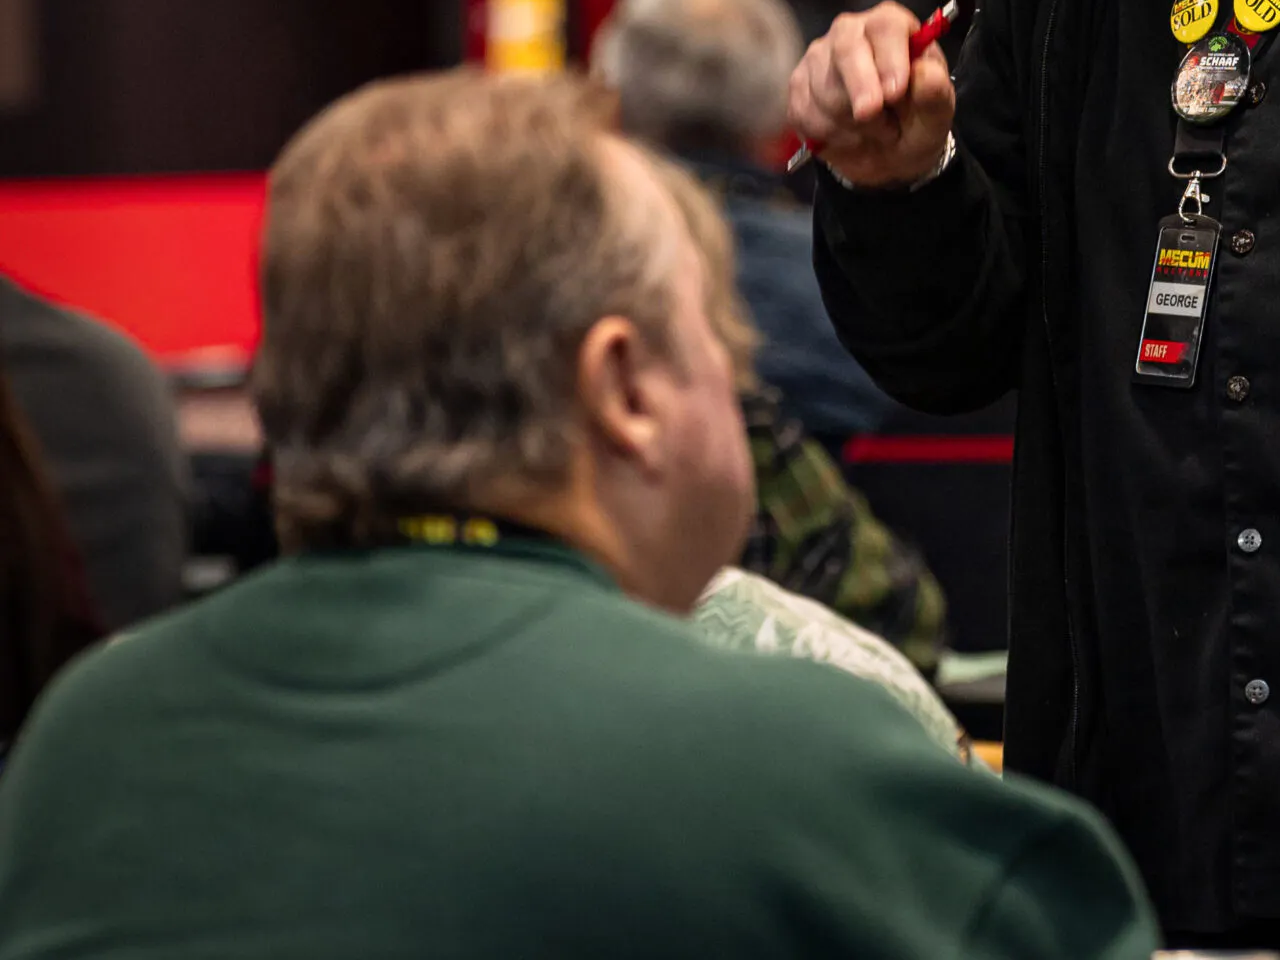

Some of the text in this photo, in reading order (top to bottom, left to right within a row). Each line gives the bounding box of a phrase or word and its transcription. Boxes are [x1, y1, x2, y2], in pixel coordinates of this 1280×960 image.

[1173, 1, 1212, 32] SOLD
[1200, 56, 1240, 67] SCHAAF
[1158, 248, 1211, 269] MECUM
[1156, 292, 1199, 309] GEORGE
[1144, 343, 1168, 359] STAFF
